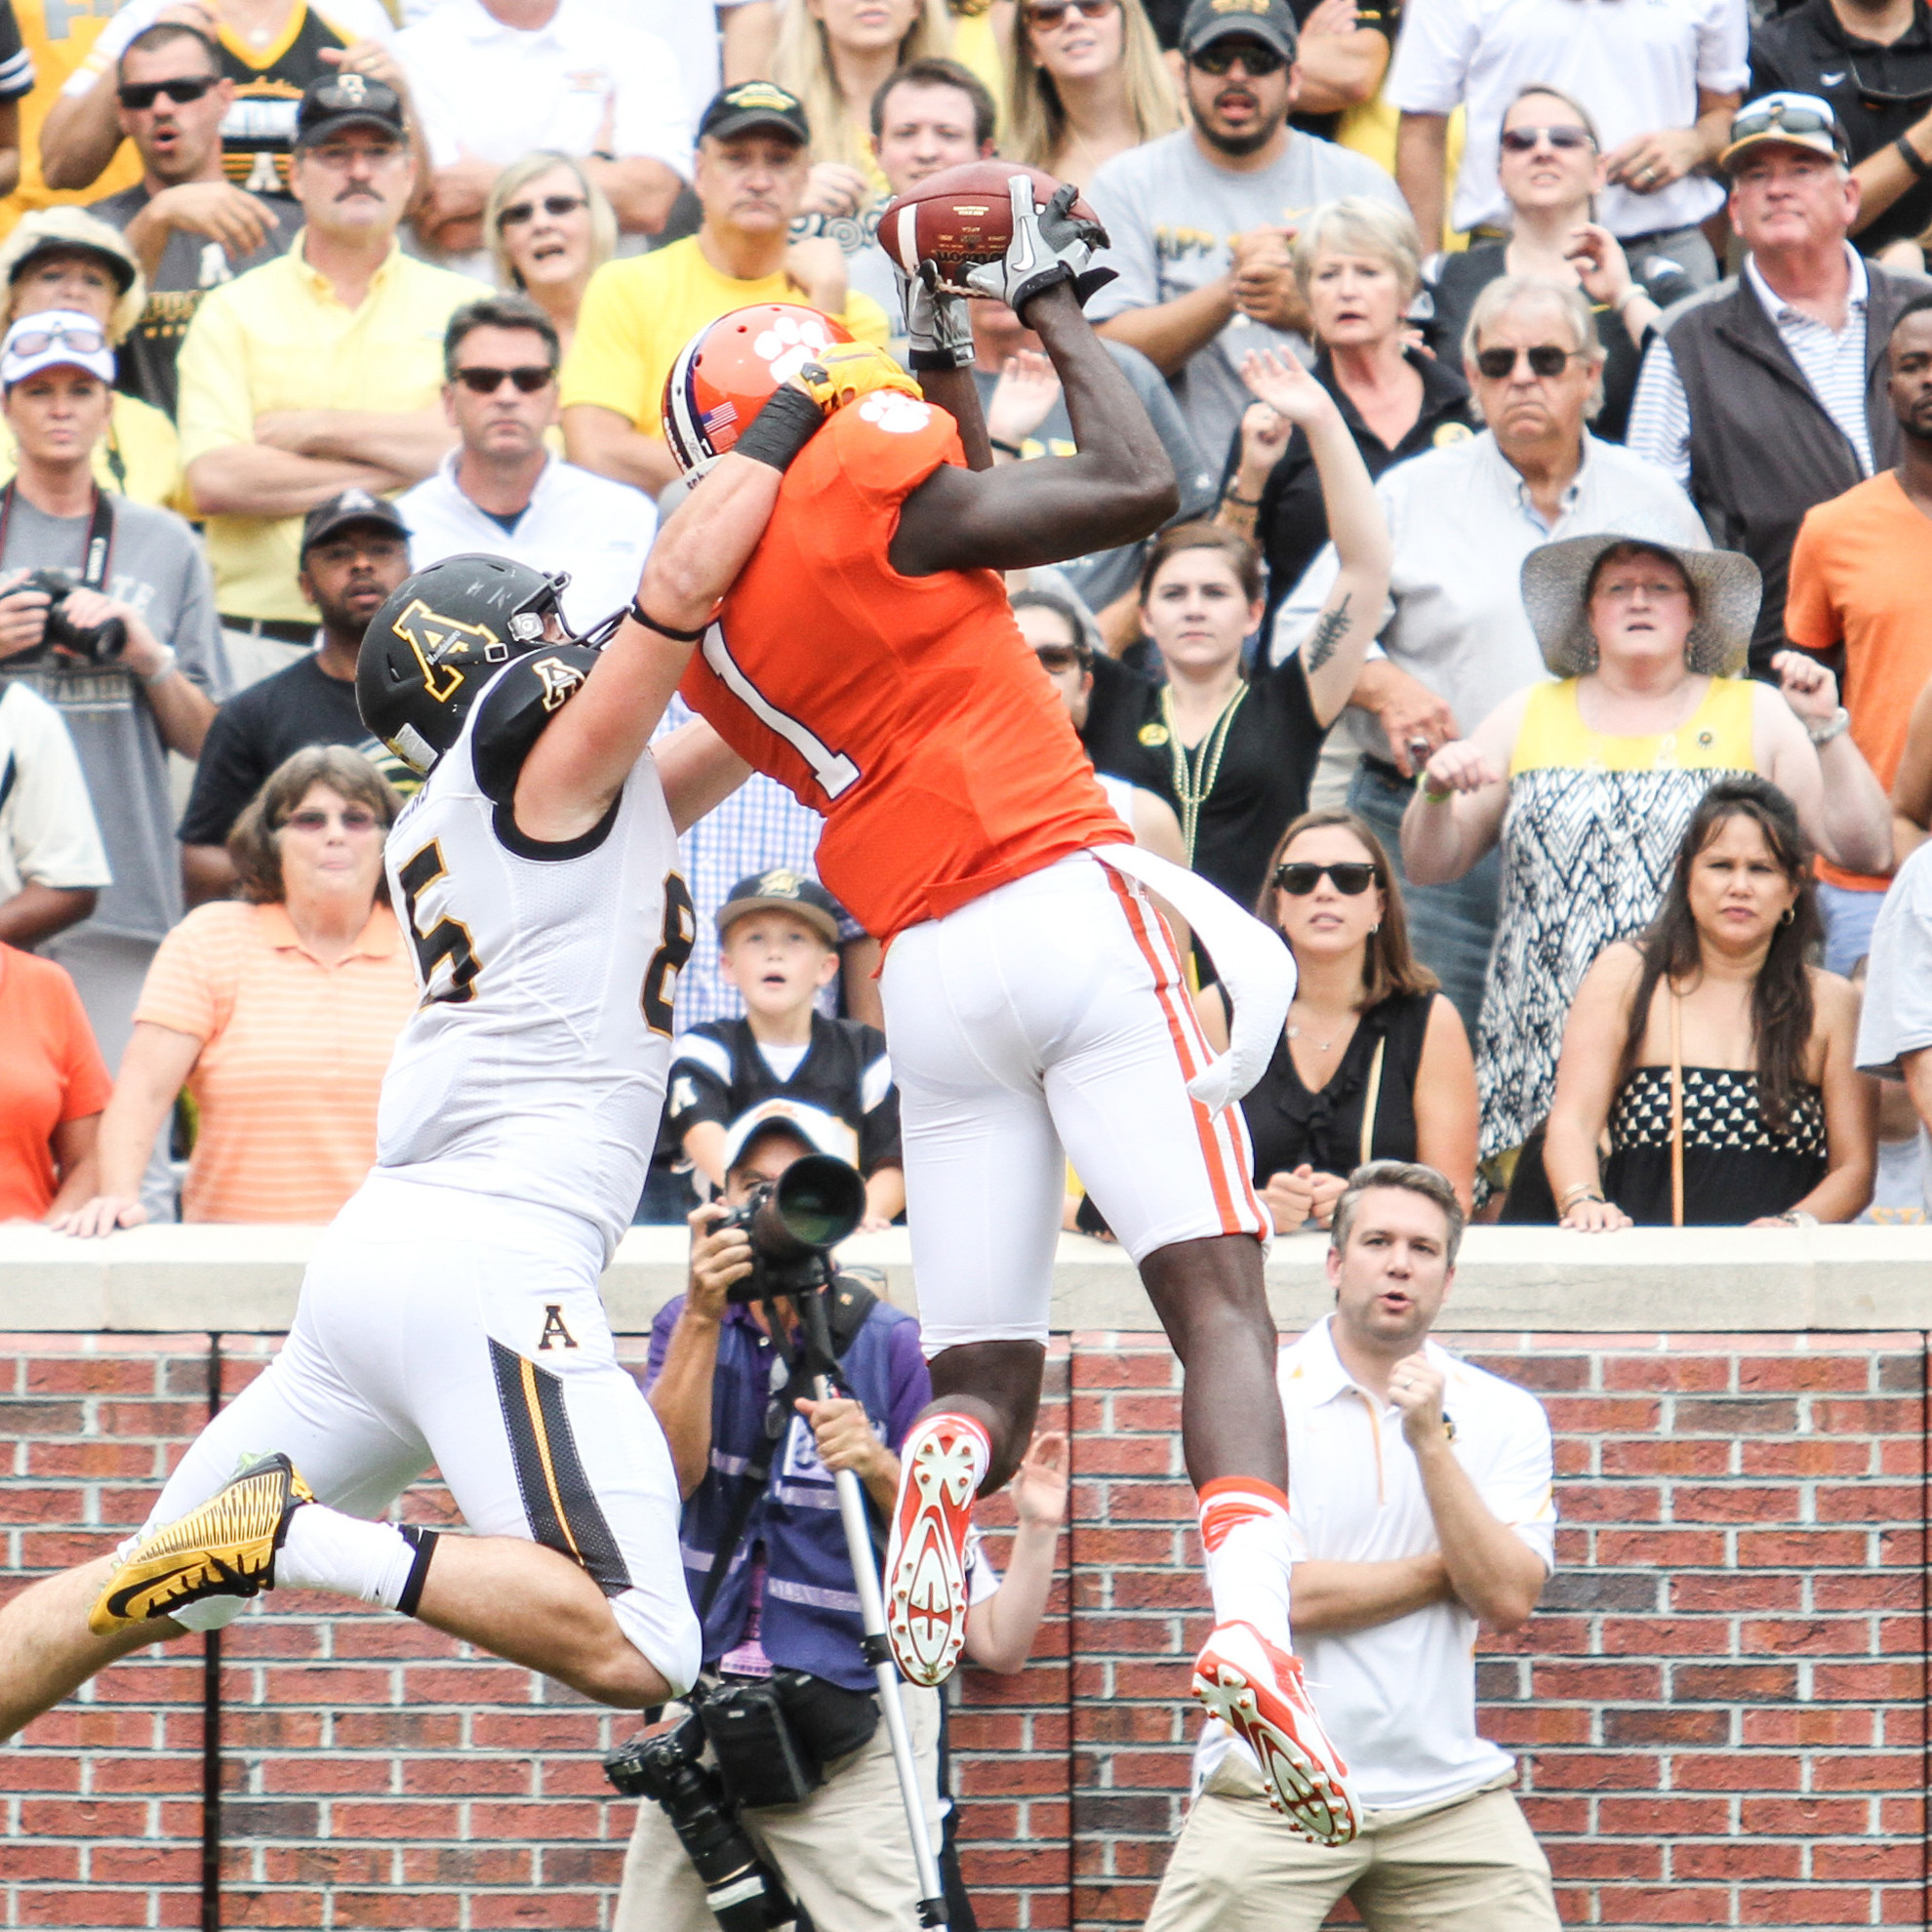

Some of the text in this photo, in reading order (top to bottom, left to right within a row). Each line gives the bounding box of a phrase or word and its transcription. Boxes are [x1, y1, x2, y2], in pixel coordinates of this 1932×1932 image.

[391, 598, 501, 704] A
[533, 656, 585, 712] A
[702, 617, 862, 801] 1
[398, 836, 484, 1014] 5
[639, 868, 697, 1041] 8
[538, 1305, 579, 1350] A
